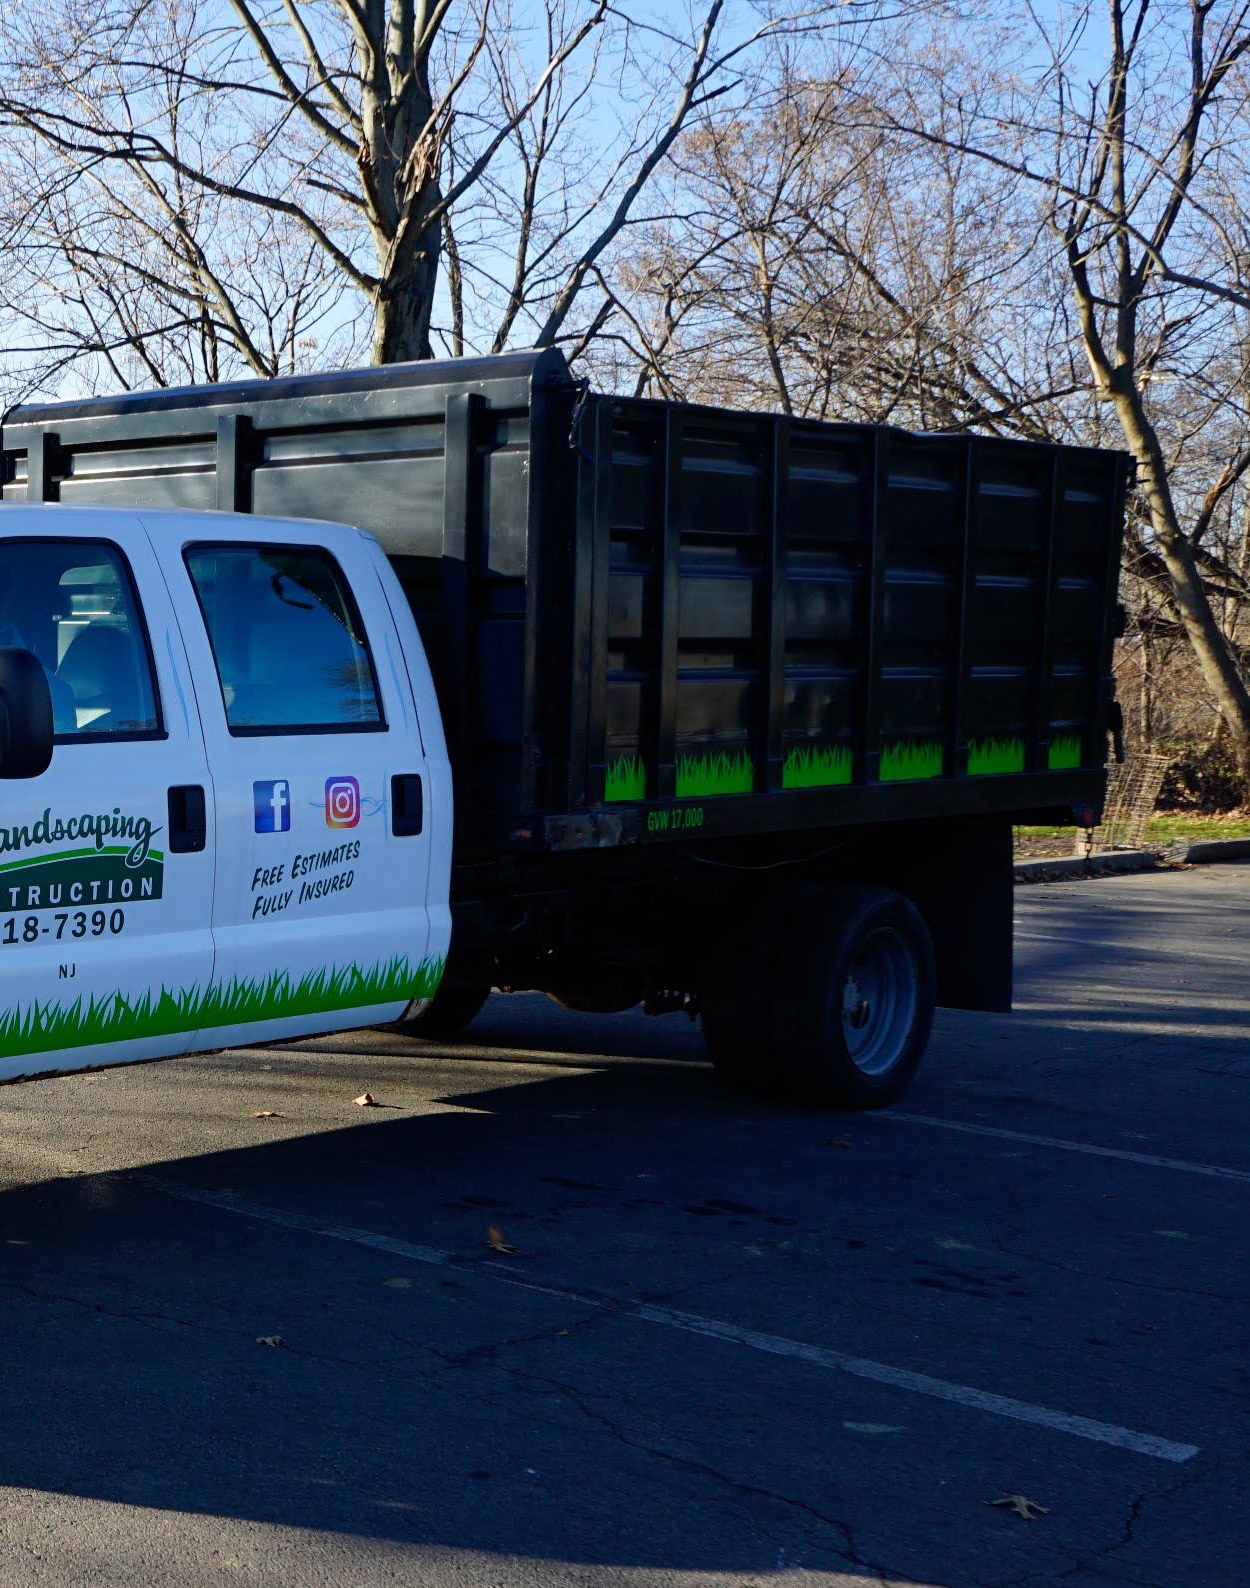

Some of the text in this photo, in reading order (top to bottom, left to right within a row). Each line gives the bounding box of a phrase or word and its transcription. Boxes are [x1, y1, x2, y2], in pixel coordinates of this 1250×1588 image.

[648, 807, 703, 831] GVW 17,000
[251, 840, 360, 892] FREE ESTIMATES
[252, 870, 354, 920] FULLY INSURED
[58, 963, 76, 979] NJ
